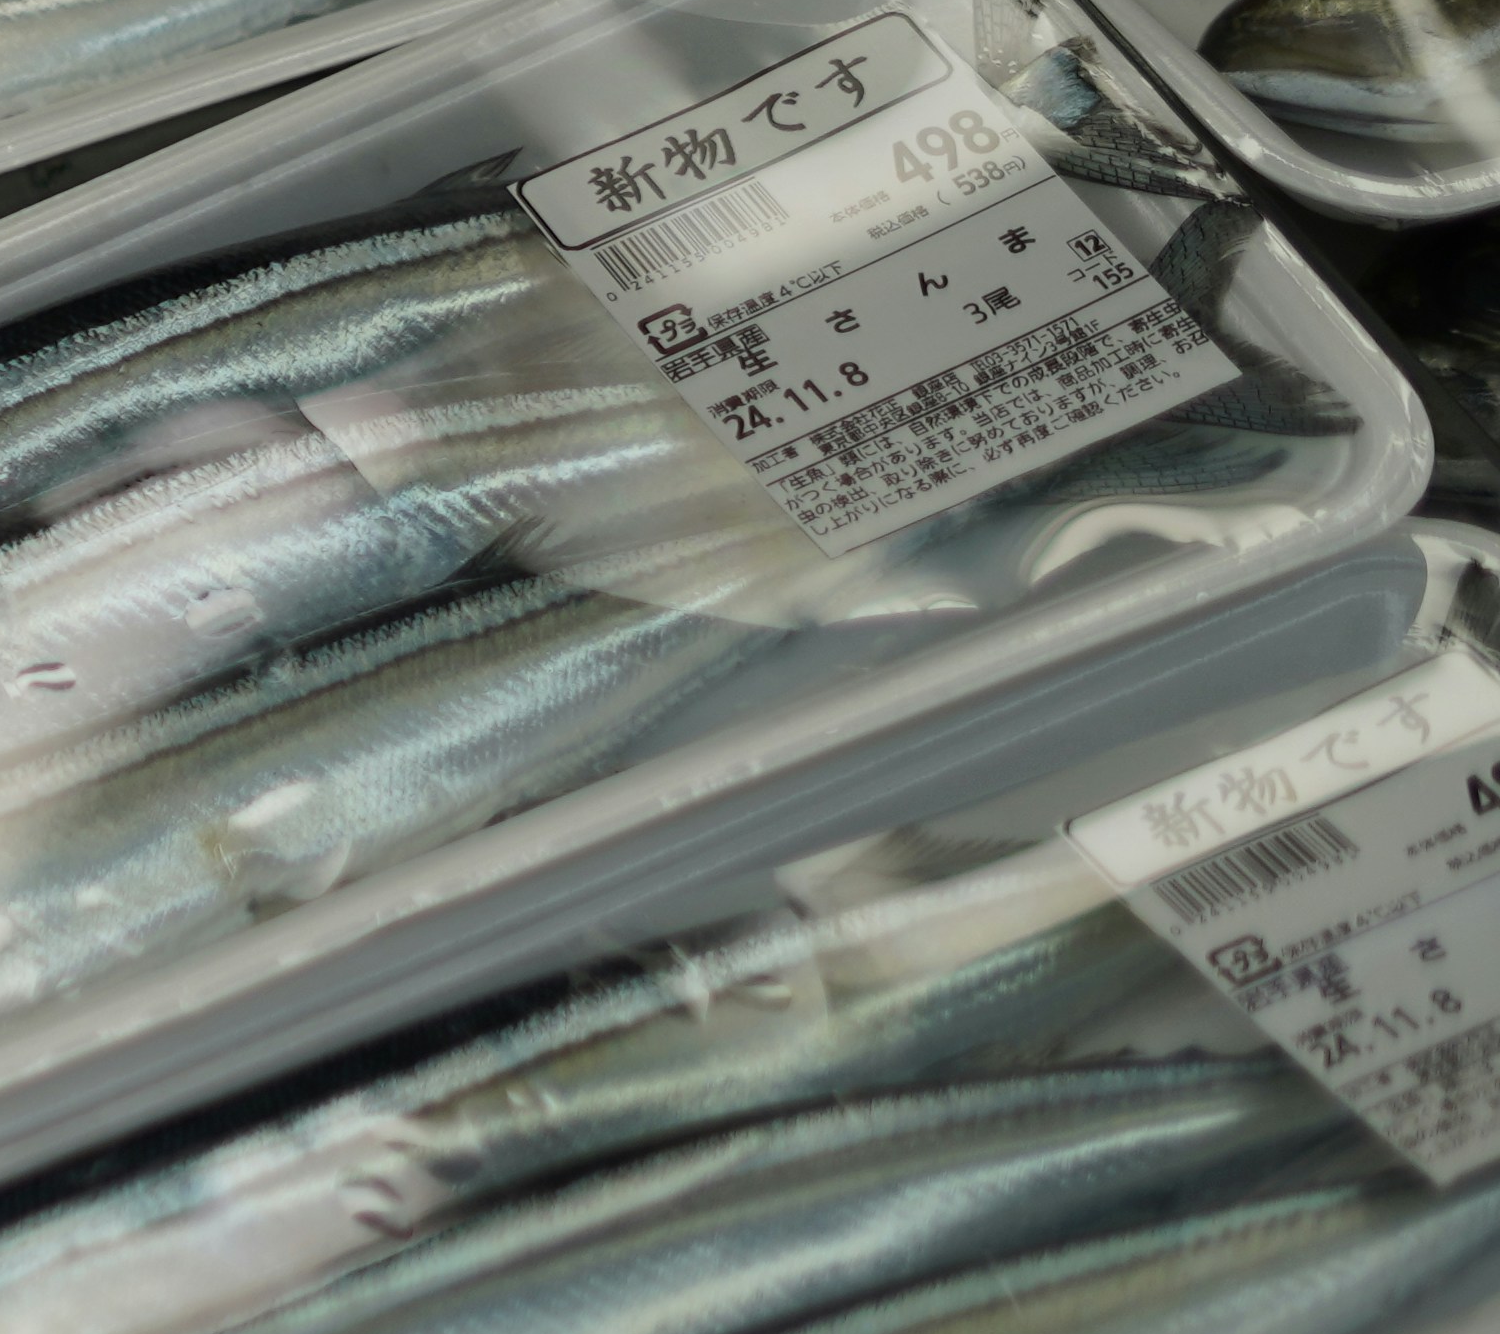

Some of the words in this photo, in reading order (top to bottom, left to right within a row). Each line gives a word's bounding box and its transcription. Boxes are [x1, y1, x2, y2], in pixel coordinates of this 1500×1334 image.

[589, 57, 864, 210] 新物です
[828, 190, 891, 224] 本体価格
[1074, 235, 1108, 257] 12
[1092, 262, 1136, 290] 155
[962, 285, 1022, 324] 3尾
[665, 326, 768, 382] 岩手県産
[708, 379, 781, 419] 消費期限
[1142, 698, 1429, 848] 新物です
